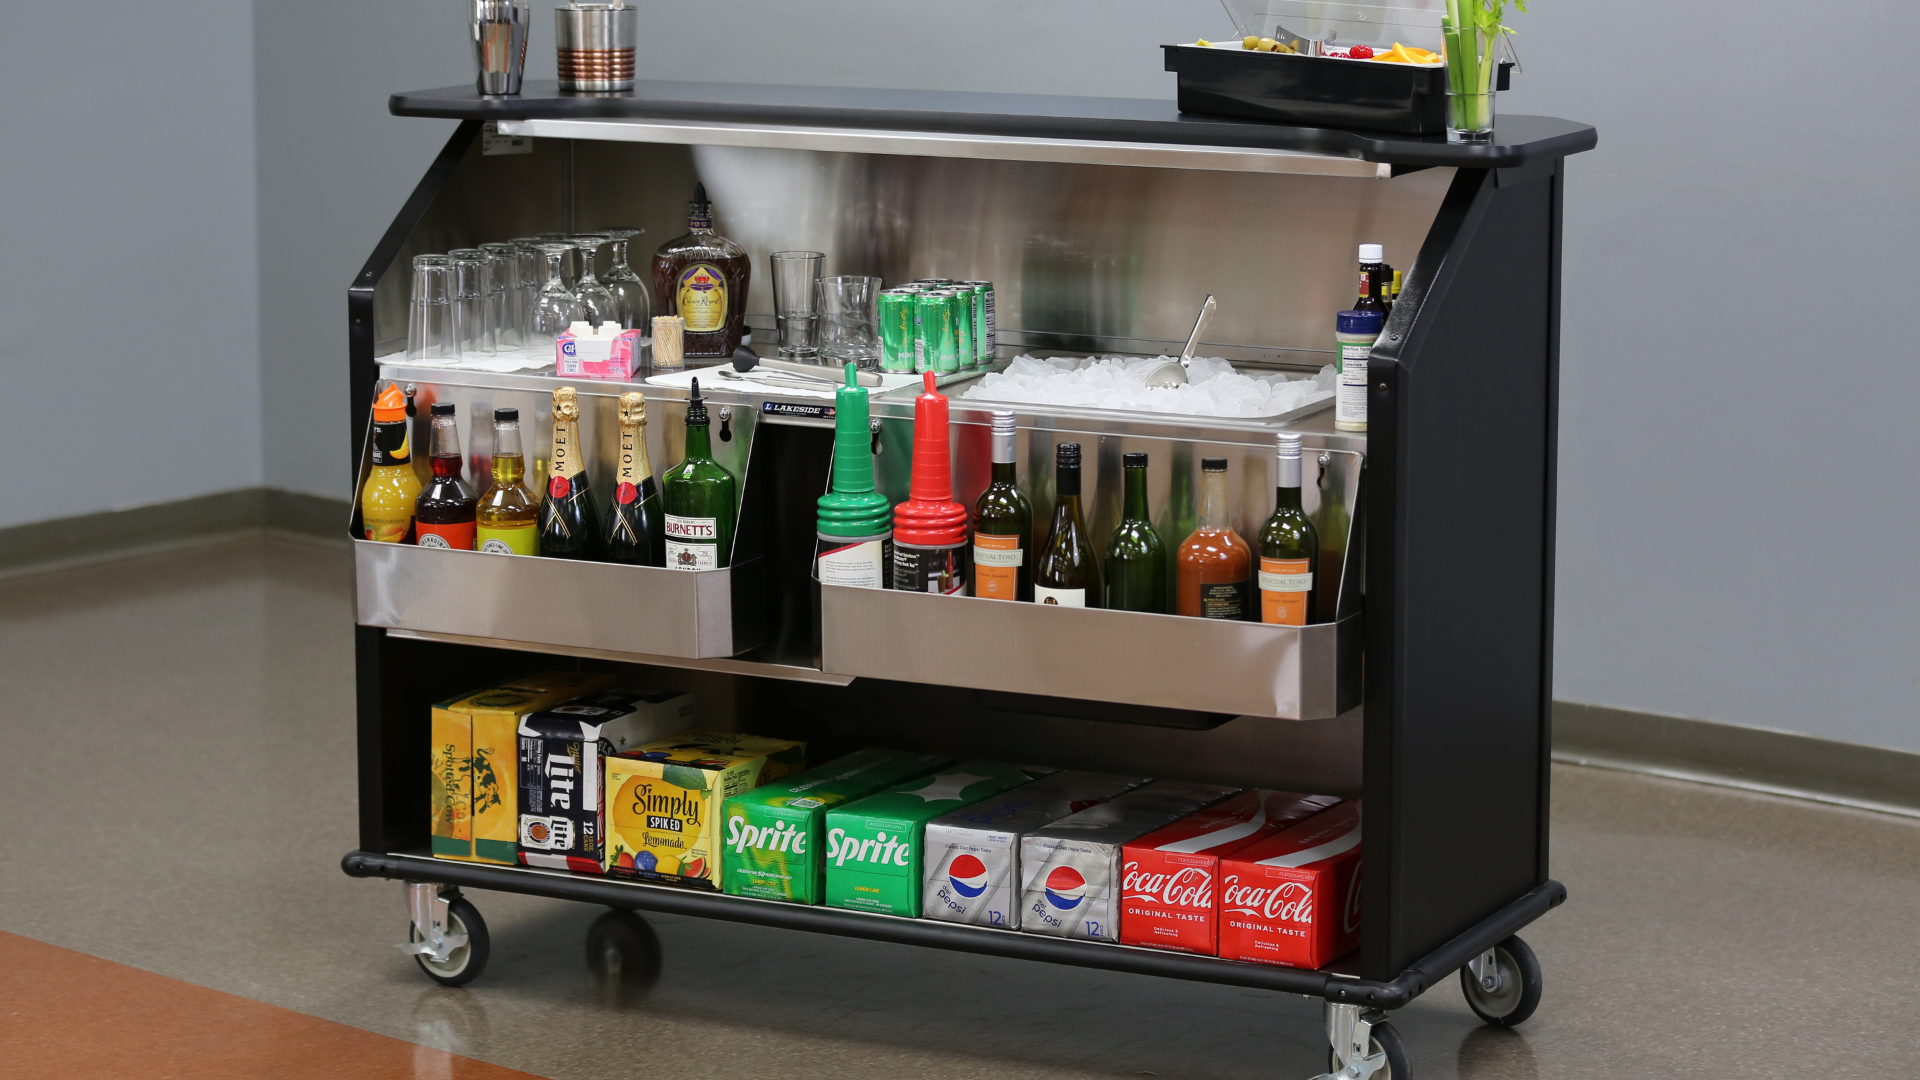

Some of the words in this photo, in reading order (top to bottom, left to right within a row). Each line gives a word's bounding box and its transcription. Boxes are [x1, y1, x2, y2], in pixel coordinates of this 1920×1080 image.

[682, 296, 700, 306] Crown
[696, 296, 721, 306] Royal
[774, 404, 820, 414] LAKESIDE
[666, 522, 712, 536] BURNETT'S
[975, 551, 996, 560] PASCUAL
[1262, 577, 1287, 585] PASCUAL
[566, 742, 581, 774] Miller
[442, 743, 456, 794] Spotted
[544, 752, 574, 810] Lite
[445, 796, 455, 824] Cow
[632, 784, 701, 828] Simply
[583, 821, 594, 835] 12
[650, 816, 680, 831] SPIKED
[550, 820, 568, 848] Lite
[642, 832, 684, 849] Lemonade
[726, 815, 806, 854] Sprite
[827, 828, 909, 866] Sprite
[943, 885, 952, 895] diet
[937, 889, 967, 914] pepsi
[1037, 899, 1047, 910] diet
[988, 910, 1002, 926] 12
[1032, 903, 1063, 928] pepsi
[1128, 908, 1173, 919] ORIGINAL
[1176, 914, 1205, 922] TASTE
[1086, 921, 1100, 937] 12
[1230, 921, 1274, 932] ORIGINAL
[1277, 927, 1306, 937] TASTE
